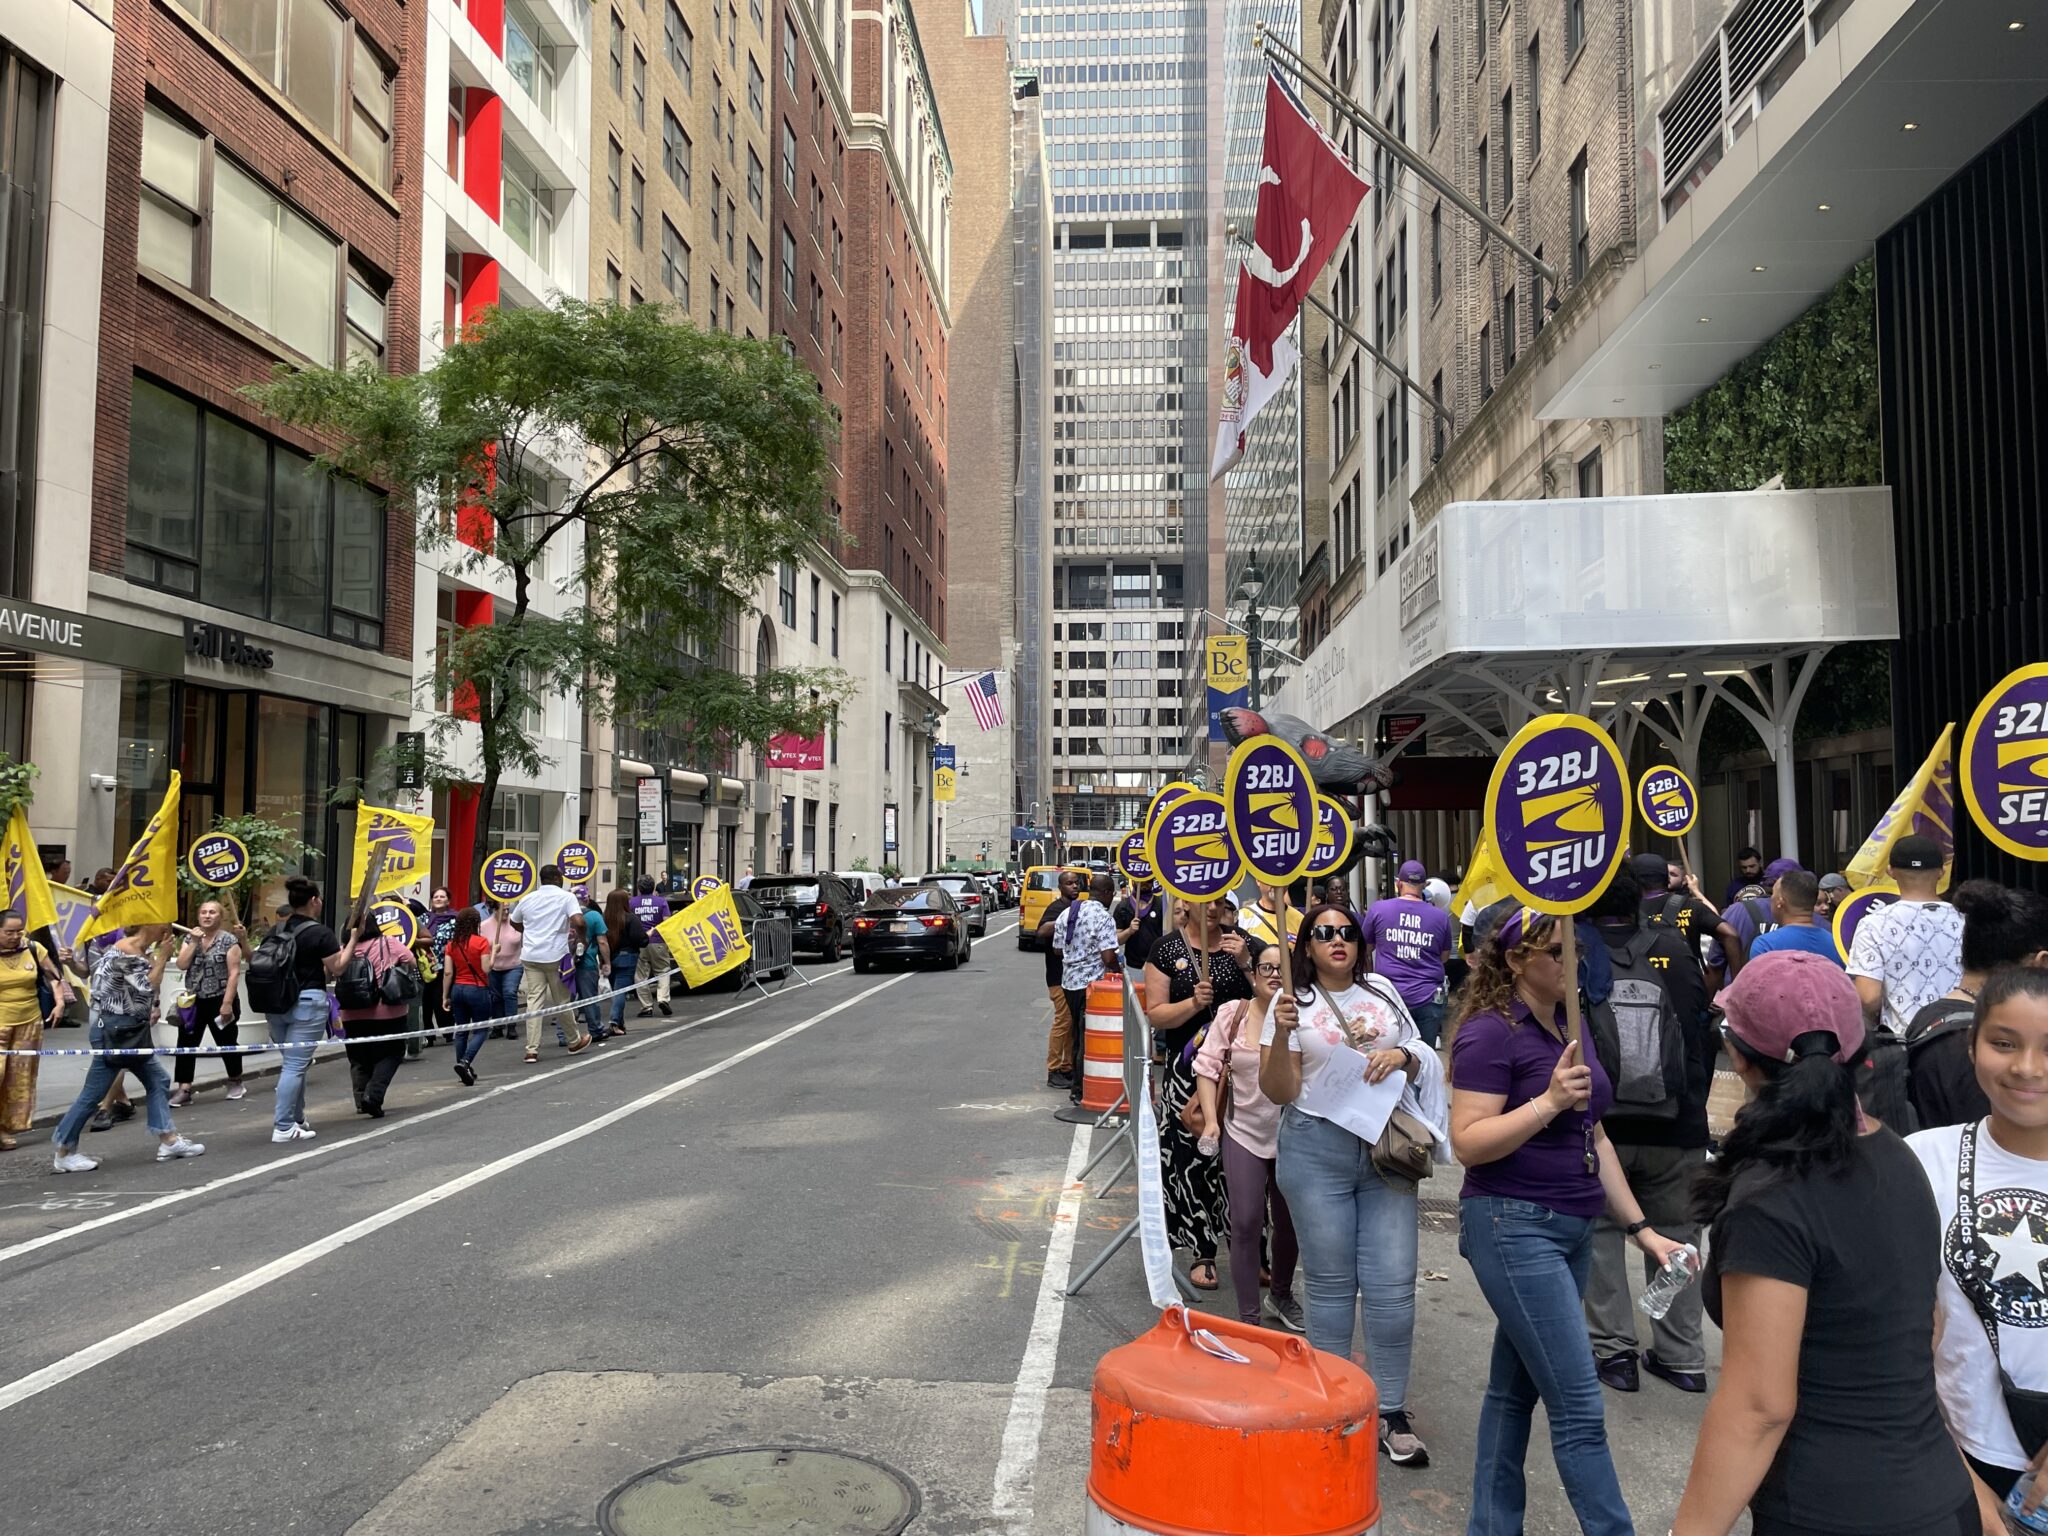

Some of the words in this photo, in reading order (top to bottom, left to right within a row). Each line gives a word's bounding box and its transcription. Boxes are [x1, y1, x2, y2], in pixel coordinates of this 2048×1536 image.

[0, 609, 83, 648] AVENUE
[1211, 651, 1243, 676] Be
[936, 773, 953, 787] Be
[1245, 764, 1295, 790] 32BJ
[1516, 745, 1599, 796] 32BJ
[1647, 775, 1679, 796] 32BJ
[1170, 811, 1228, 834] 32BJ
[1658, 806, 1689, 827] SEIU
[197, 839, 230, 858] 32BJ
[563, 847, 588, 857] 32BJ
[1128, 838, 1145, 848] 32
[1251, 831, 1301, 859] SEIU
[365, 855, 415, 875] EIU
[493, 858, 525, 869] 32BJ
[1527, 833, 1606, 885] SEIU
[208, 861, 240, 881] SEIU
[564, 866, 589, 876] SEIU
[1174, 860, 1230, 884] SEIU
[491, 883, 523, 893] SEIU
[634, 906, 659, 915] CONTRACT
[641, 898, 653, 906] FAIR
[375, 908, 400, 925] 2BJ
[640, 914, 654, 922] NOW!
[1399, 912, 1421, 929] FAIR
[718, 907, 745, 951] 32BJ
[1386, 928, 1434, 947] CONTRACT
[683, 927, 716, 967] SEIU
[1396, 944, 1421, 960] NOW!
[1959, 1133, 1974, 1174] adidas
[1959, 1194, 1974, 1244] adidas
